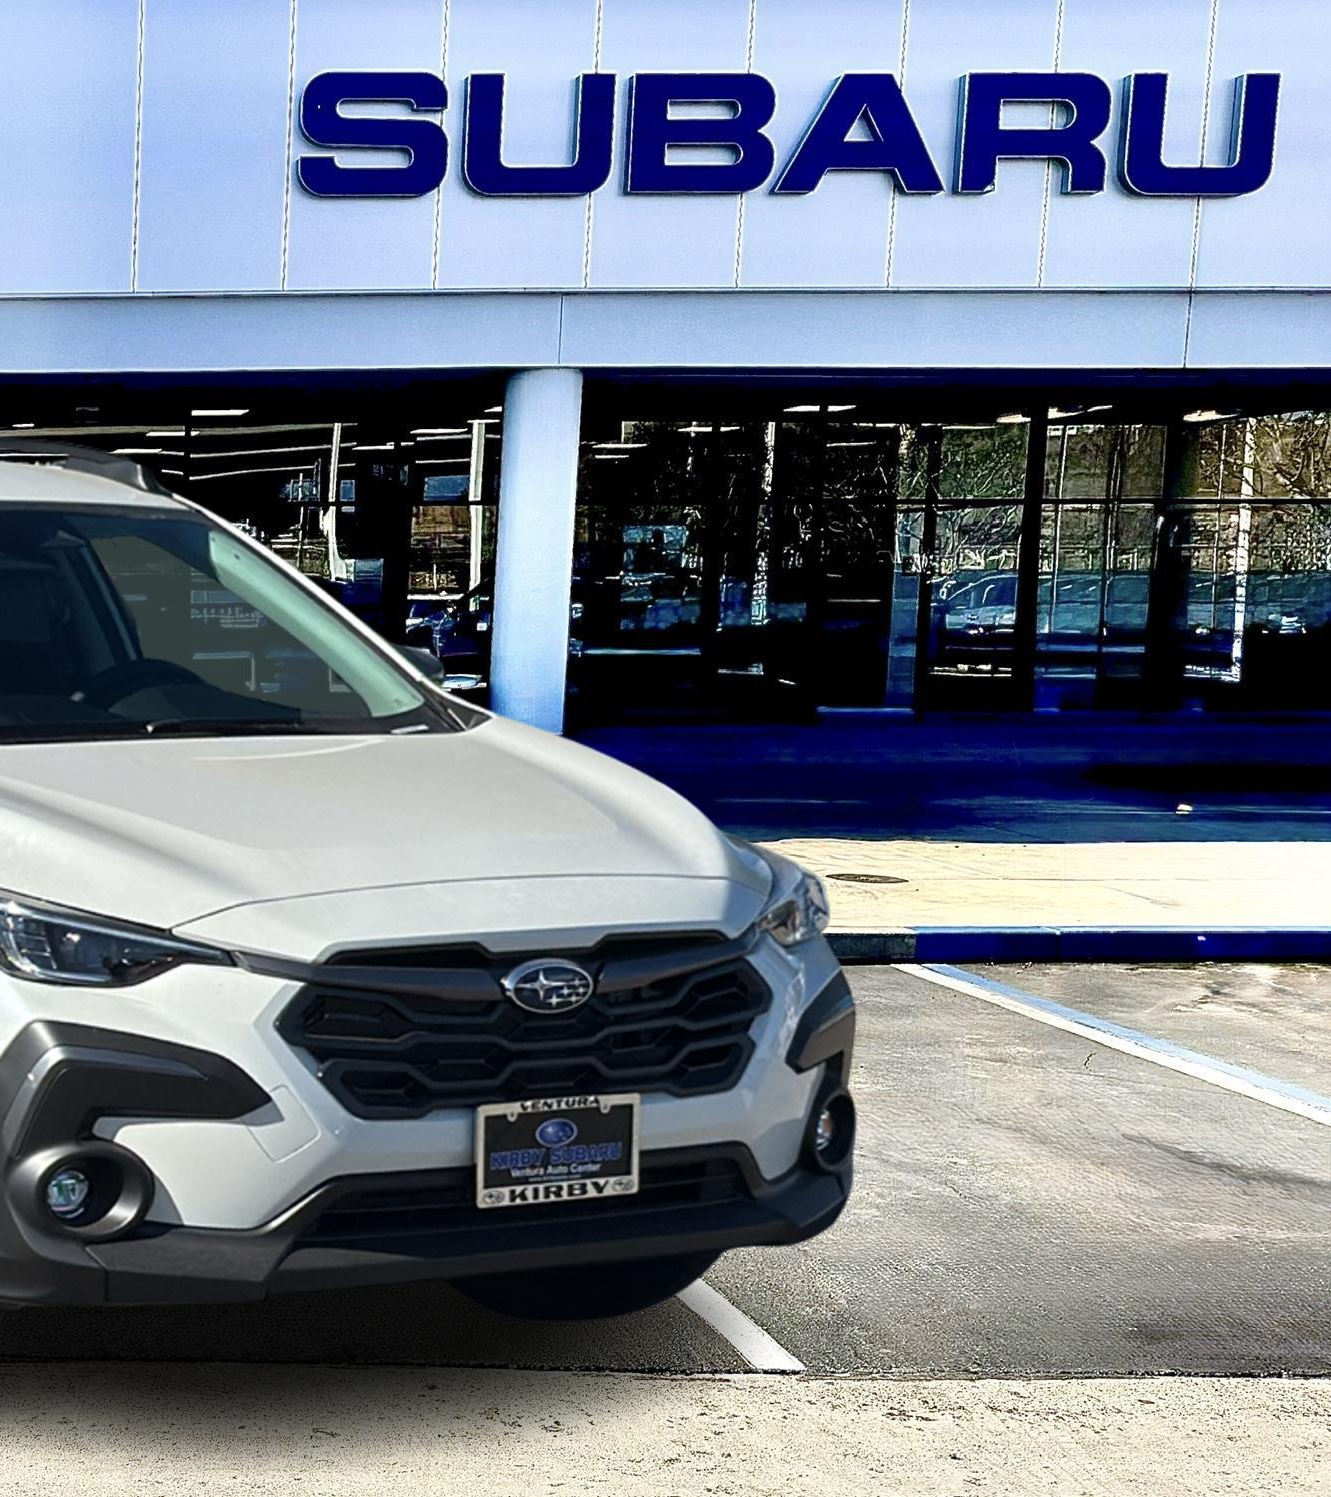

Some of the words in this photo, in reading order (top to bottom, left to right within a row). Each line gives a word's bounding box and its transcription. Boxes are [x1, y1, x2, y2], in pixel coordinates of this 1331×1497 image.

[297, 71, 1281, 197] SUBARU
[521, 1097, 600, 1112] VENTURA
[490, 1148, 546, 1170] KIRBY
[550, 1142, 623, 1163] SUBARU
[511, 1166, 545, 1178] Ventura
[546, 1164, 568, 1174] Auto
[570, 1162, 602, 1173] Center
[508, 1180, 610, 1203] KIRBY
